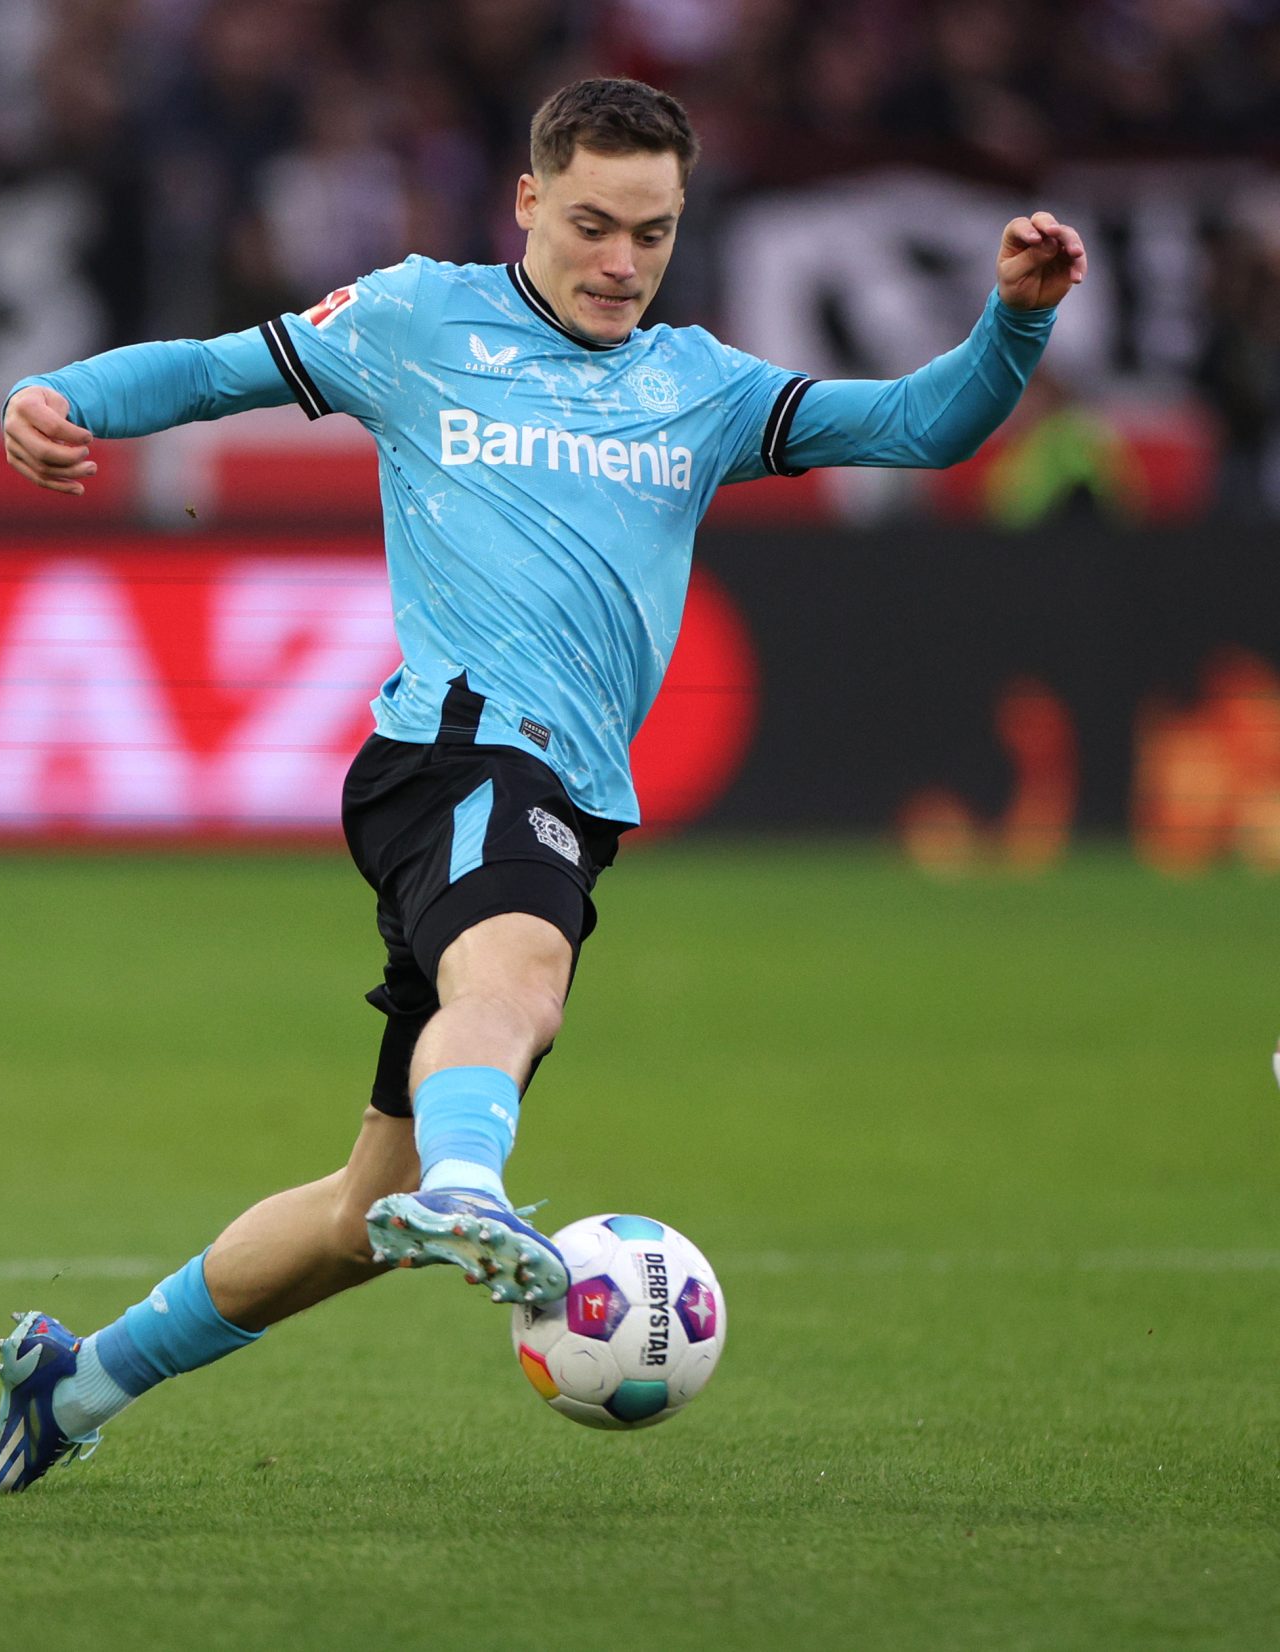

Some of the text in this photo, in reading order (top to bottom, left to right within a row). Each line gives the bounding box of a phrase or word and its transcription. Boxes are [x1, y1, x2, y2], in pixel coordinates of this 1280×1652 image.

[465, 362, 513, 376] CASTORE
[439, 408, 693, 491] Barmenia
[644, 1252, 670, 1367] DERBYSTAR
